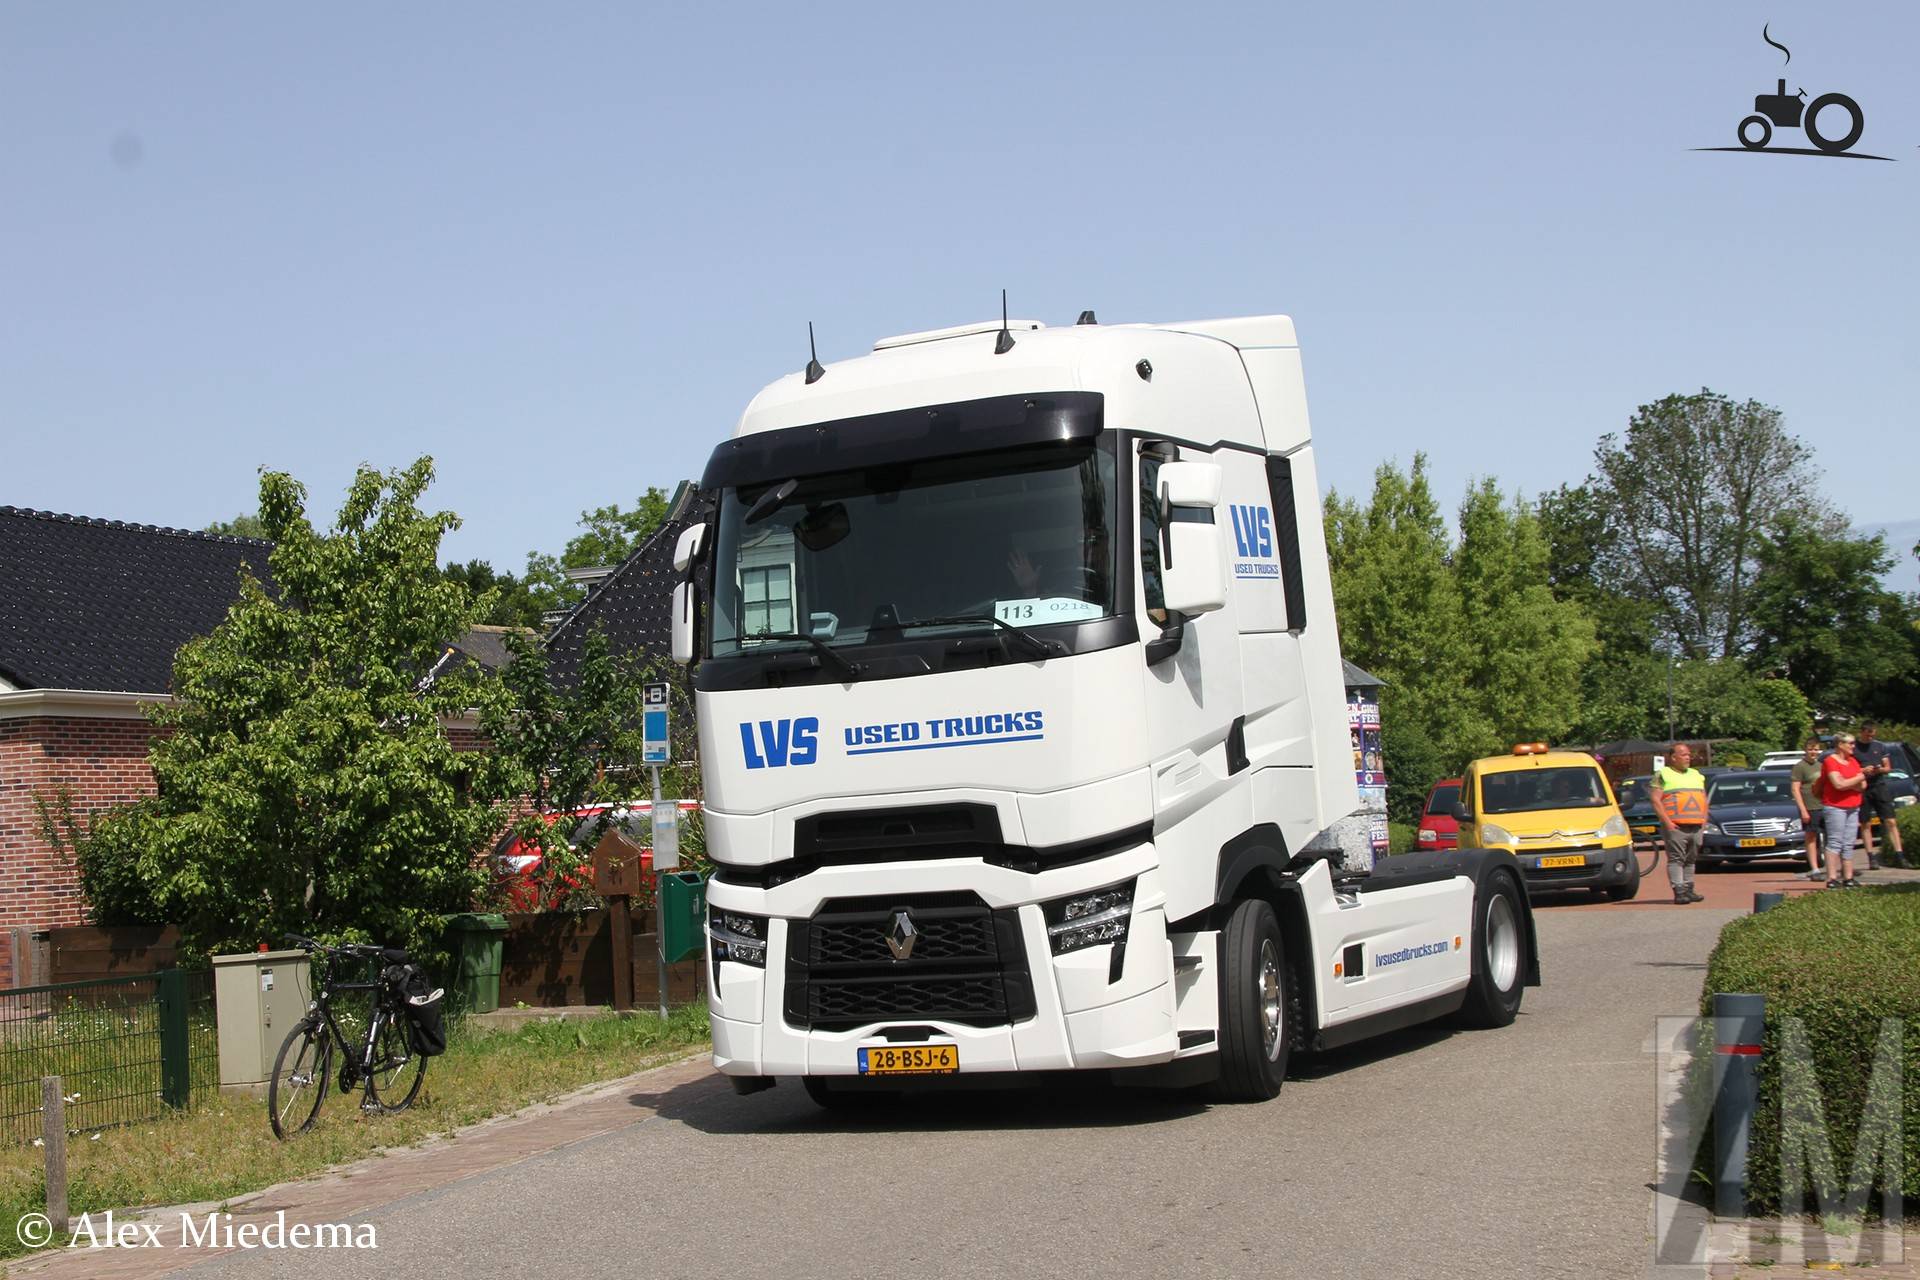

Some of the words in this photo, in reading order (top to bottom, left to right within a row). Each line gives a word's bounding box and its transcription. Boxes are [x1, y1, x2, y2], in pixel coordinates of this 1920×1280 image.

[1229, 504, 1273, 558] LVS
[1234, 563, 1254, 574] USED
[1254, 563, 1279, 575] TRUCKS
[1001, 604, 1034, 620] 113
[739, 716, 819, 770] LVS
[844, 721, 920, 746] USED
[925, 710, 1044, 739] TRUCKS
[1375, 941, 1449, 968] lvsusedtrucks.com
[874, 1048, 951, 1069] 28-BSJ-6
